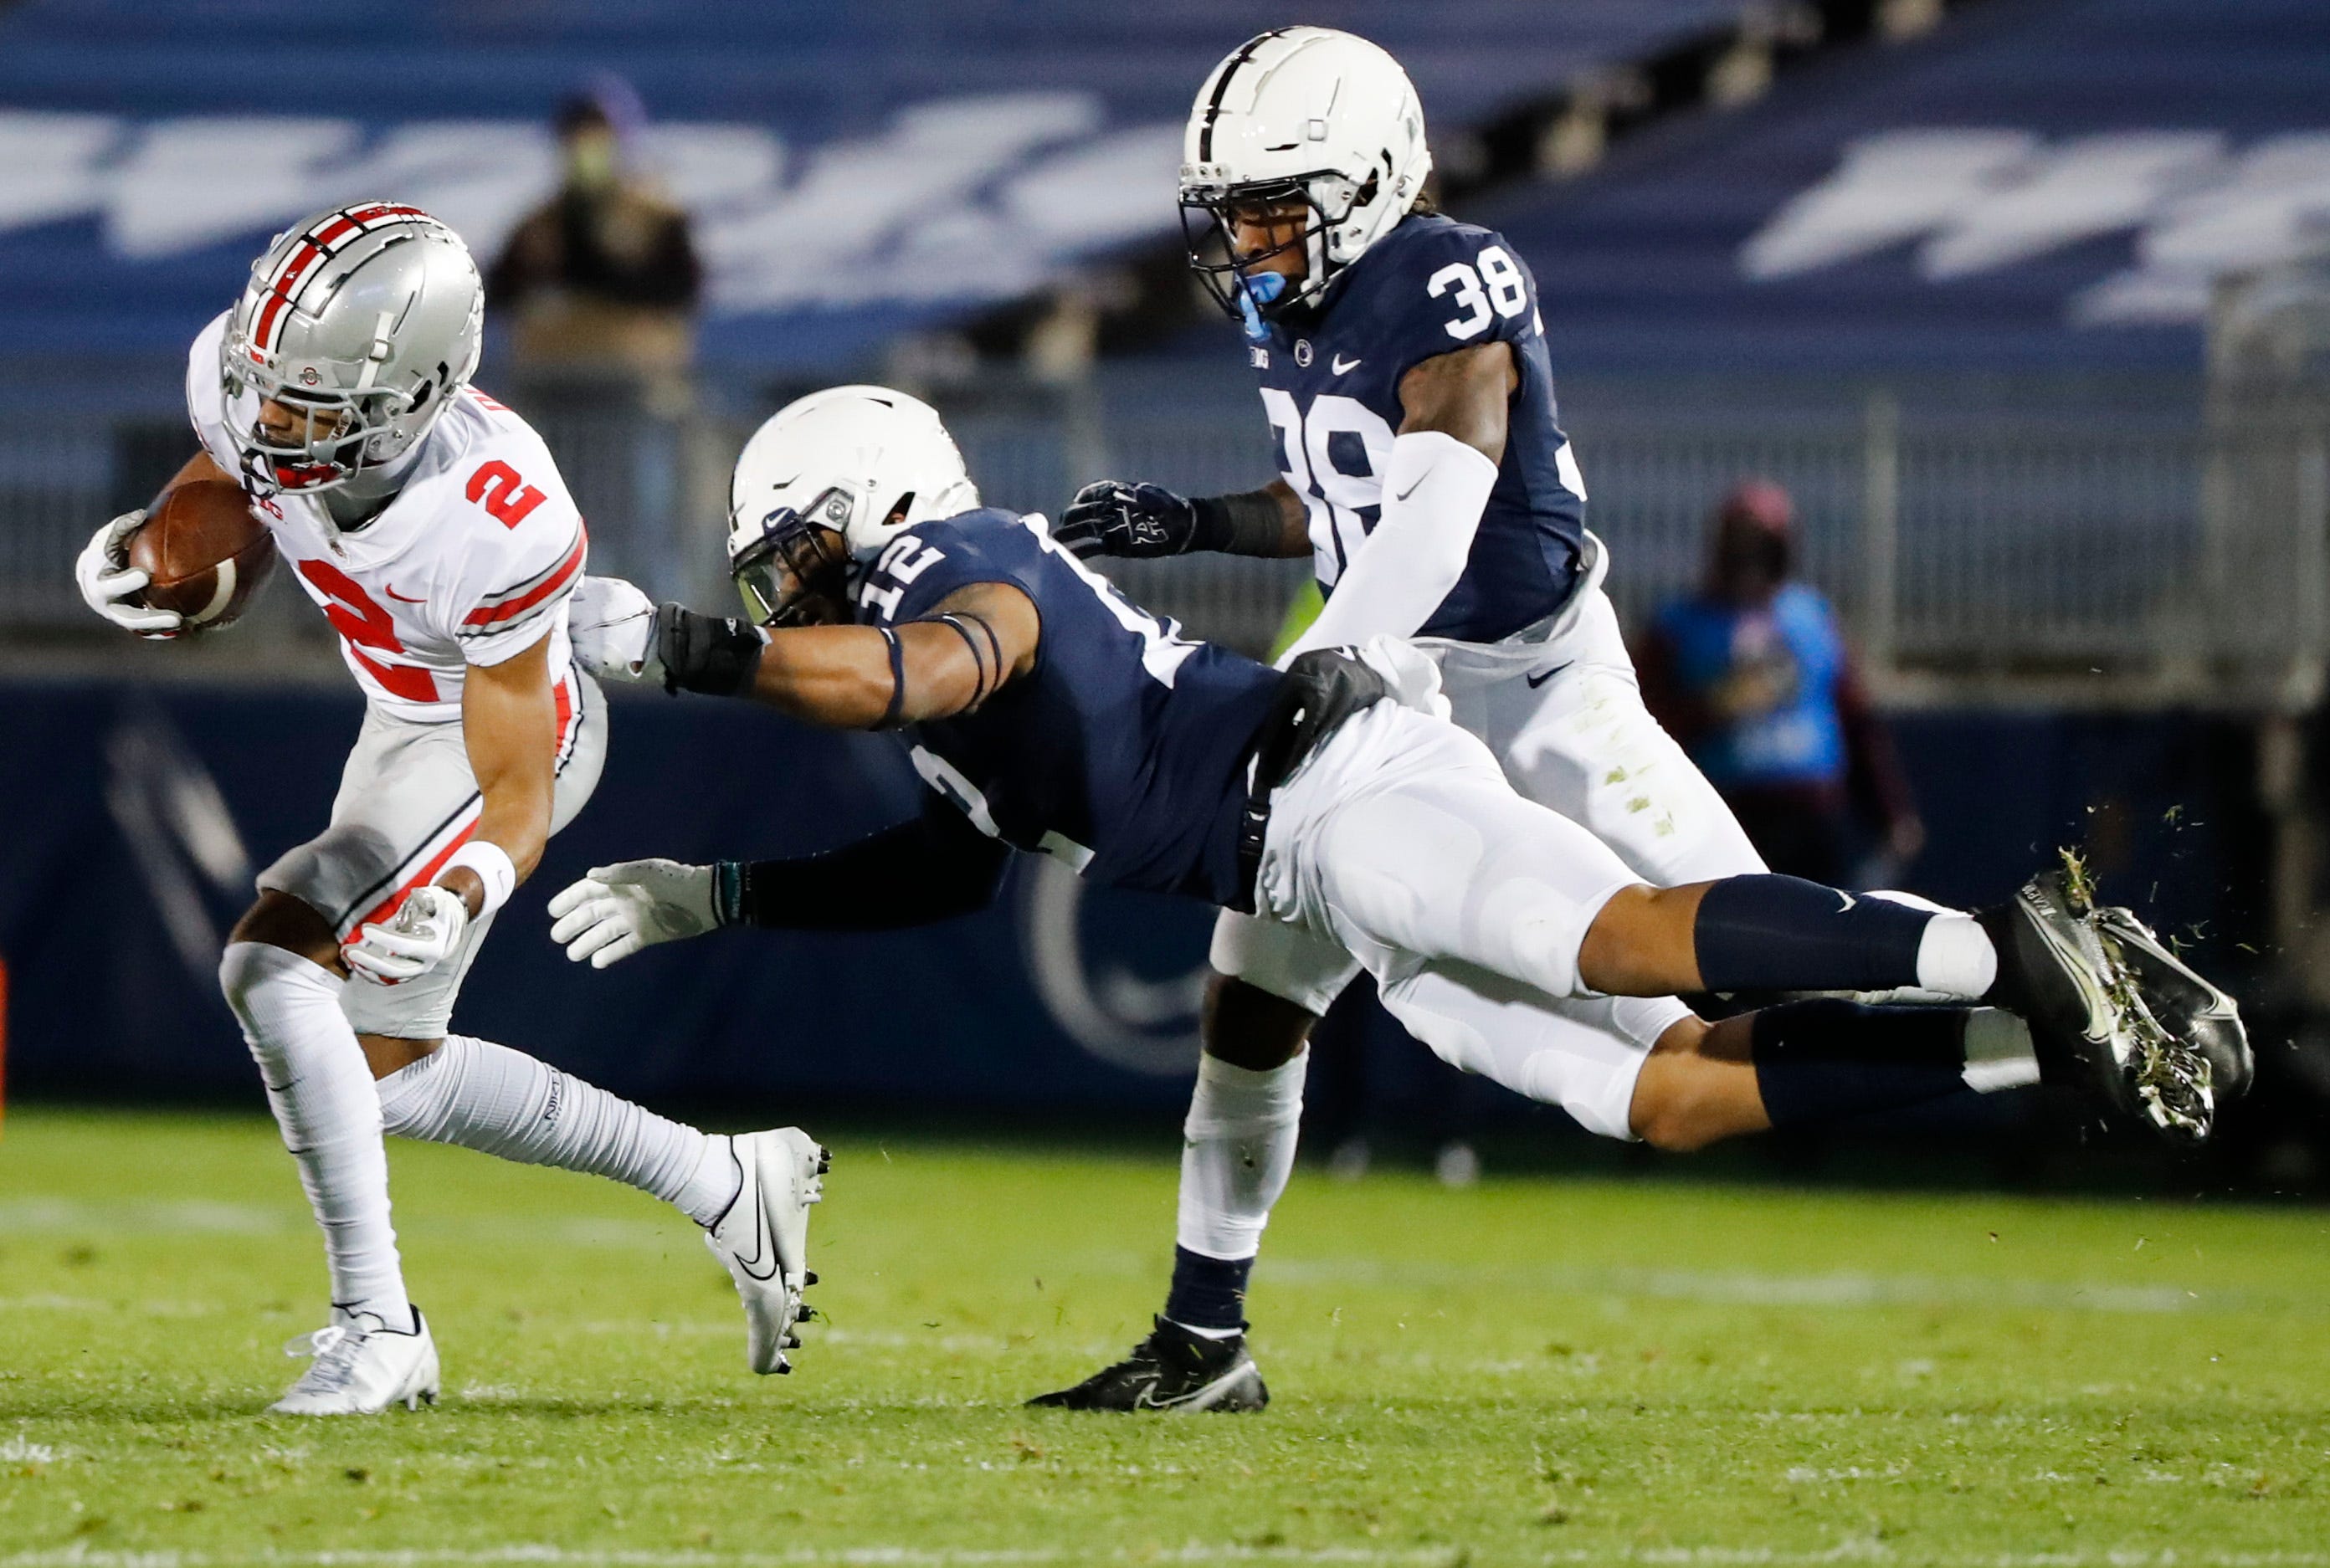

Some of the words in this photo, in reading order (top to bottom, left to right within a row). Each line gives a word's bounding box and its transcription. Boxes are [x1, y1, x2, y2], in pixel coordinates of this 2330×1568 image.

[1427, 245, 1527, 341] 38
[465, 459, 548, 530] 2
[860, 535, 946, 622] 12
[298, 559, 440, 702] 2
